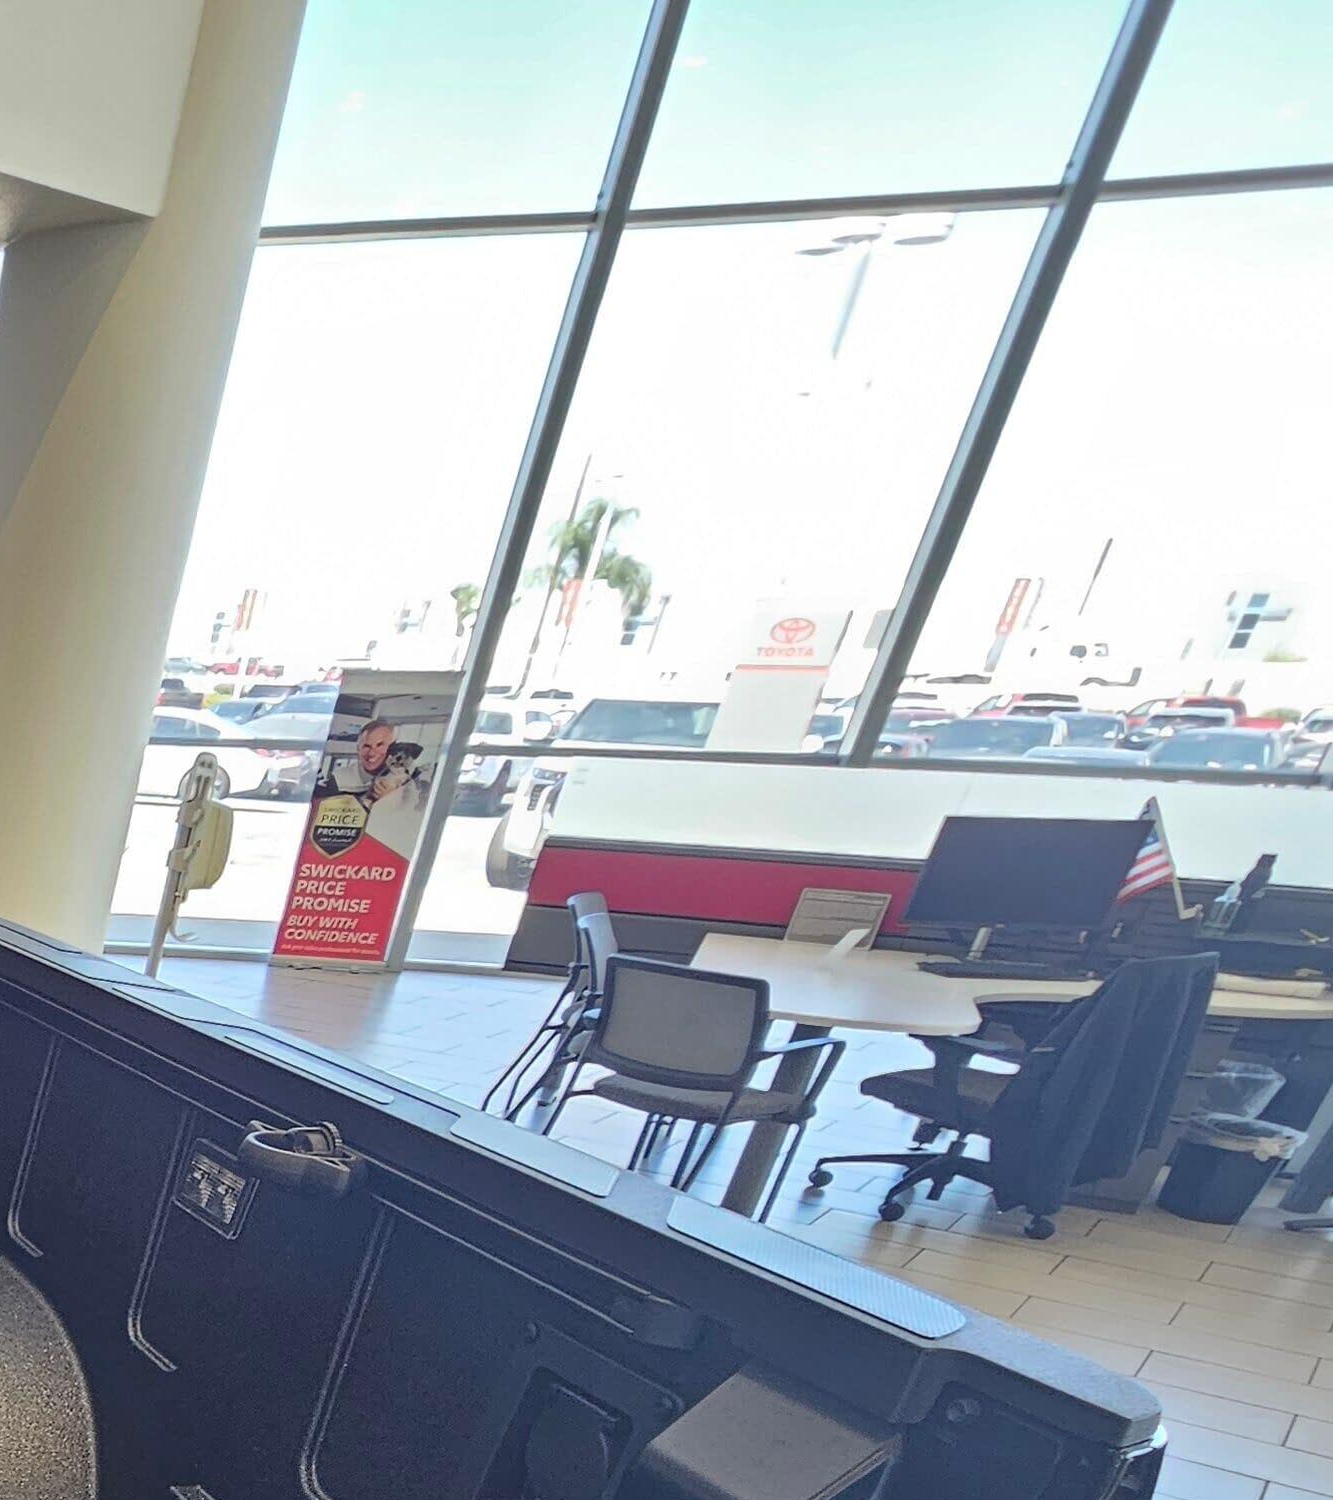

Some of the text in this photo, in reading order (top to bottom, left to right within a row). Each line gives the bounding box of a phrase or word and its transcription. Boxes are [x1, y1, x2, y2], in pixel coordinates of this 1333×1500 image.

[756, 646, 815, 657] TOYOTA
[320, 814, 359, 825] PRICE
[317, 827, 358, 837] PROMISE
[299, 863, 397, 881] SWICKARD
[295, 879, 347, 896] PRICE
[291, 896, 372, 914] PROMISE
[286, 914, 359, 930] BUY WITH
[284, 928, 380, 945] CONFIDENCE
